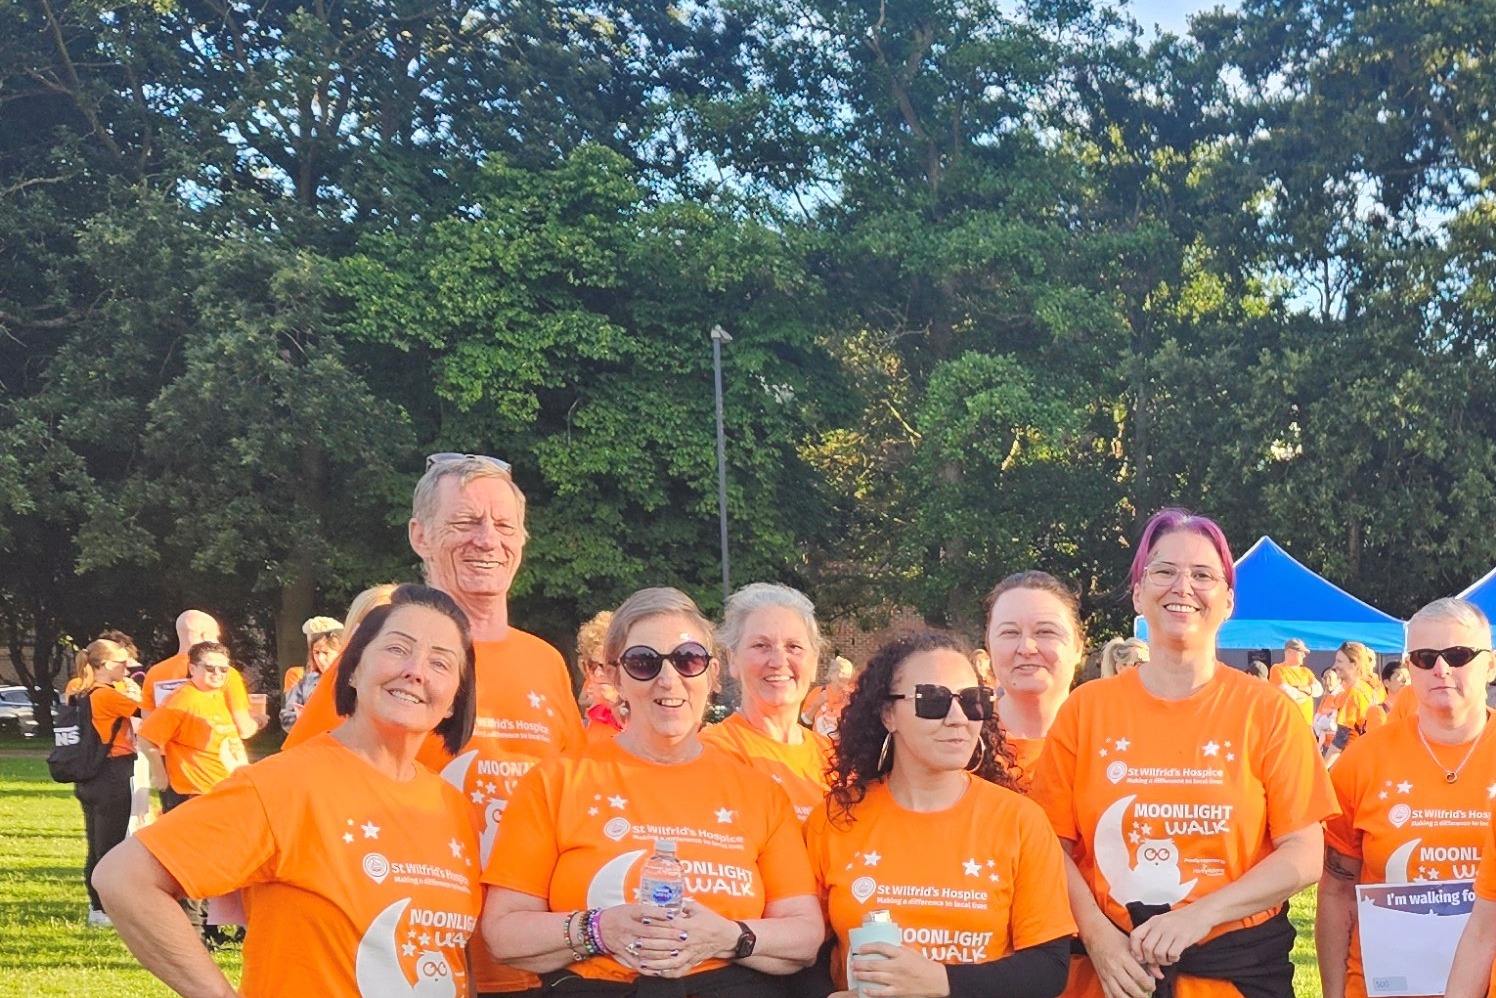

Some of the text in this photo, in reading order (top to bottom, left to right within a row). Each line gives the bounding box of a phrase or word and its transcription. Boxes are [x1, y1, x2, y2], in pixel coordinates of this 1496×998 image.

[1128, 767, 1224, 779] St Wilfrid's Hospice
[1134, 803, 1233, 820] MOONLIGHT
[1411, 810, 1423, 819] St
[1424, 809, 1467, 819] Wilfrid's
[632, 824, 745, 844] St Wilfrid's Hospice
[1164, 819, 1231, 836] WALK
[1420, 846, 1482, 862] MOONL
[391, 862, 405, 874] St
[684, 876, 755, 897] WALK
[877, 885, 988, 901] St Wilfrid's Hospice
[876, 896, 902, 906] Making
[908, 898, 944, 907] difference
[1386, 888, 1477, 906] I'm walking fo
[899, 927, 994, 947] OONLIGHT
[921, 945, 987, 964] WALK
